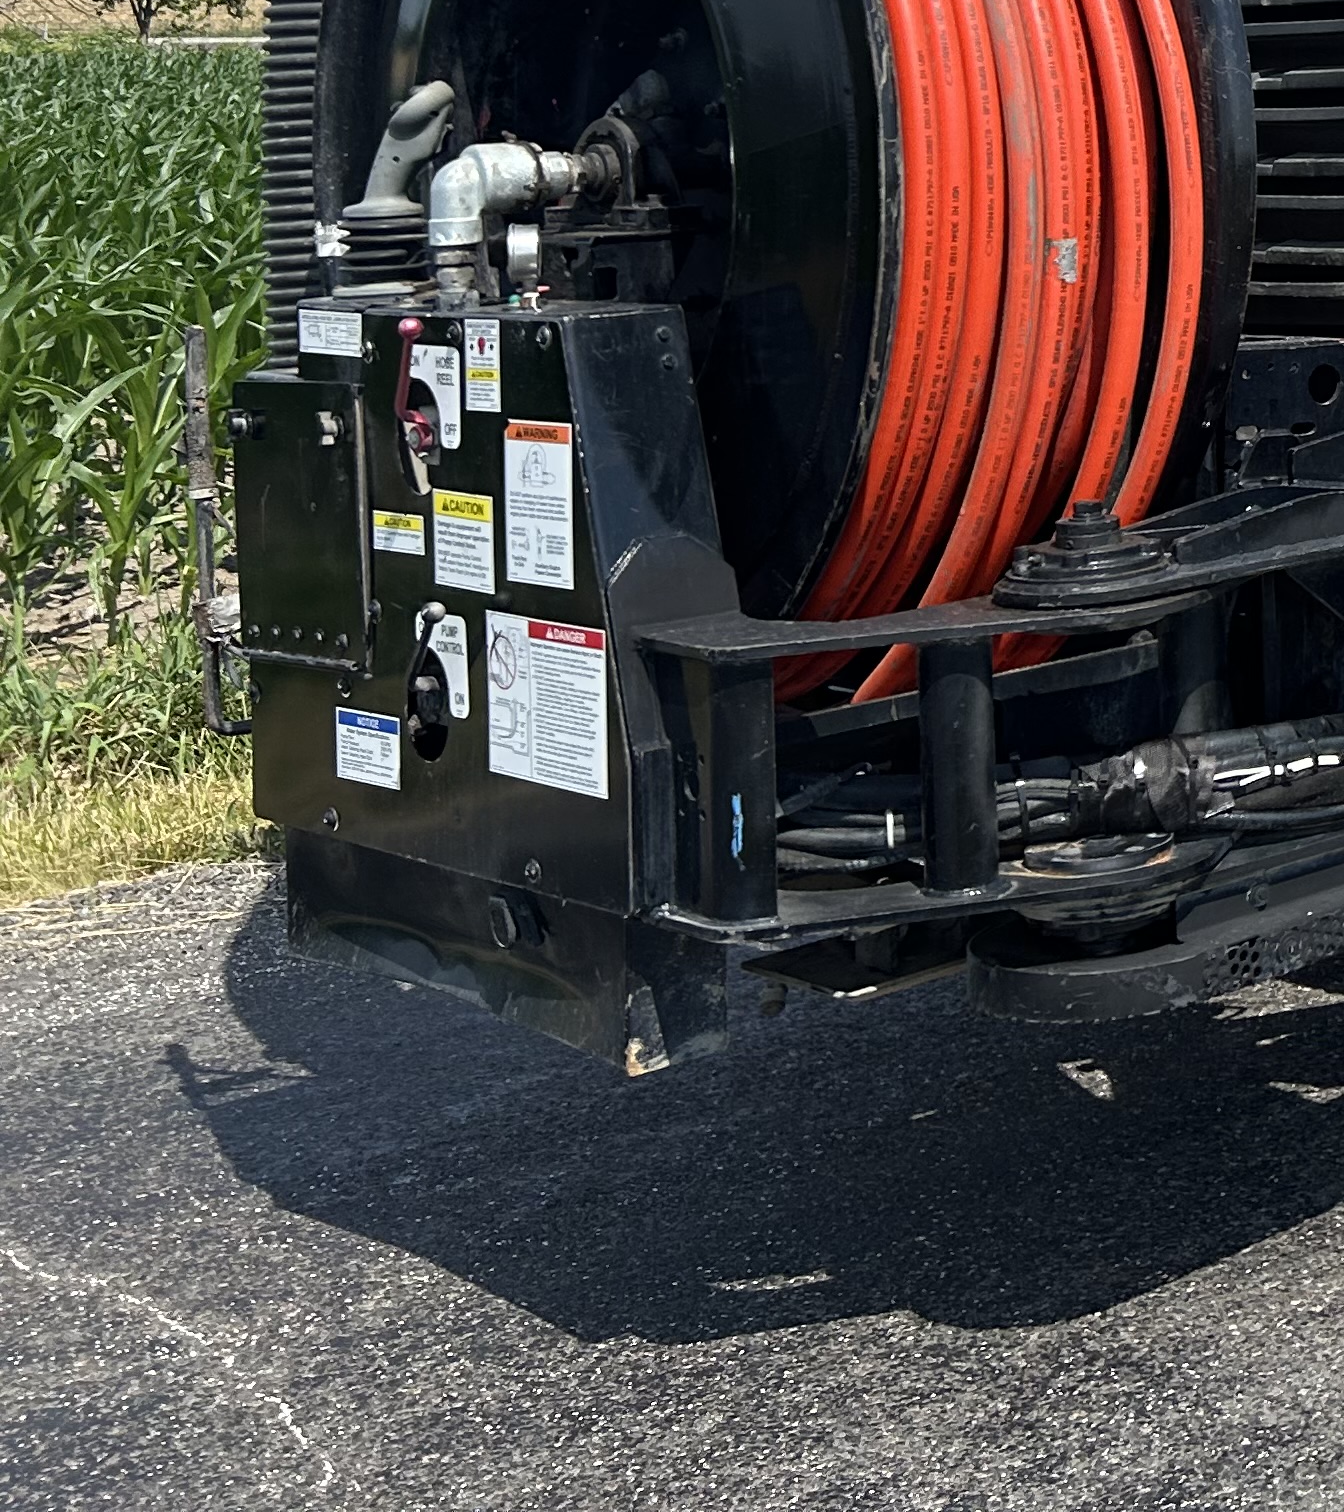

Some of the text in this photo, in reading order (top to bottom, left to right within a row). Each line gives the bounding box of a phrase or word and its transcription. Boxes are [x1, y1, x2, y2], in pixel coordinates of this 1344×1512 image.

[435, 355, 455, 370] HOSE
[436, 372, 455, 387] REEL
[444, 422, 457, 436] OFF
[523, 426, 558, 441] WARNING
[449, 499, 485, 516] CAUTION
[440, 624, 458, 638] PUMP
[553, 627, 587, 645] DANGER
[436, 640, 465, 656] CONTROL
[454, 692, 465, 706] ON
[356, 716, 380, 730] NOTICE
